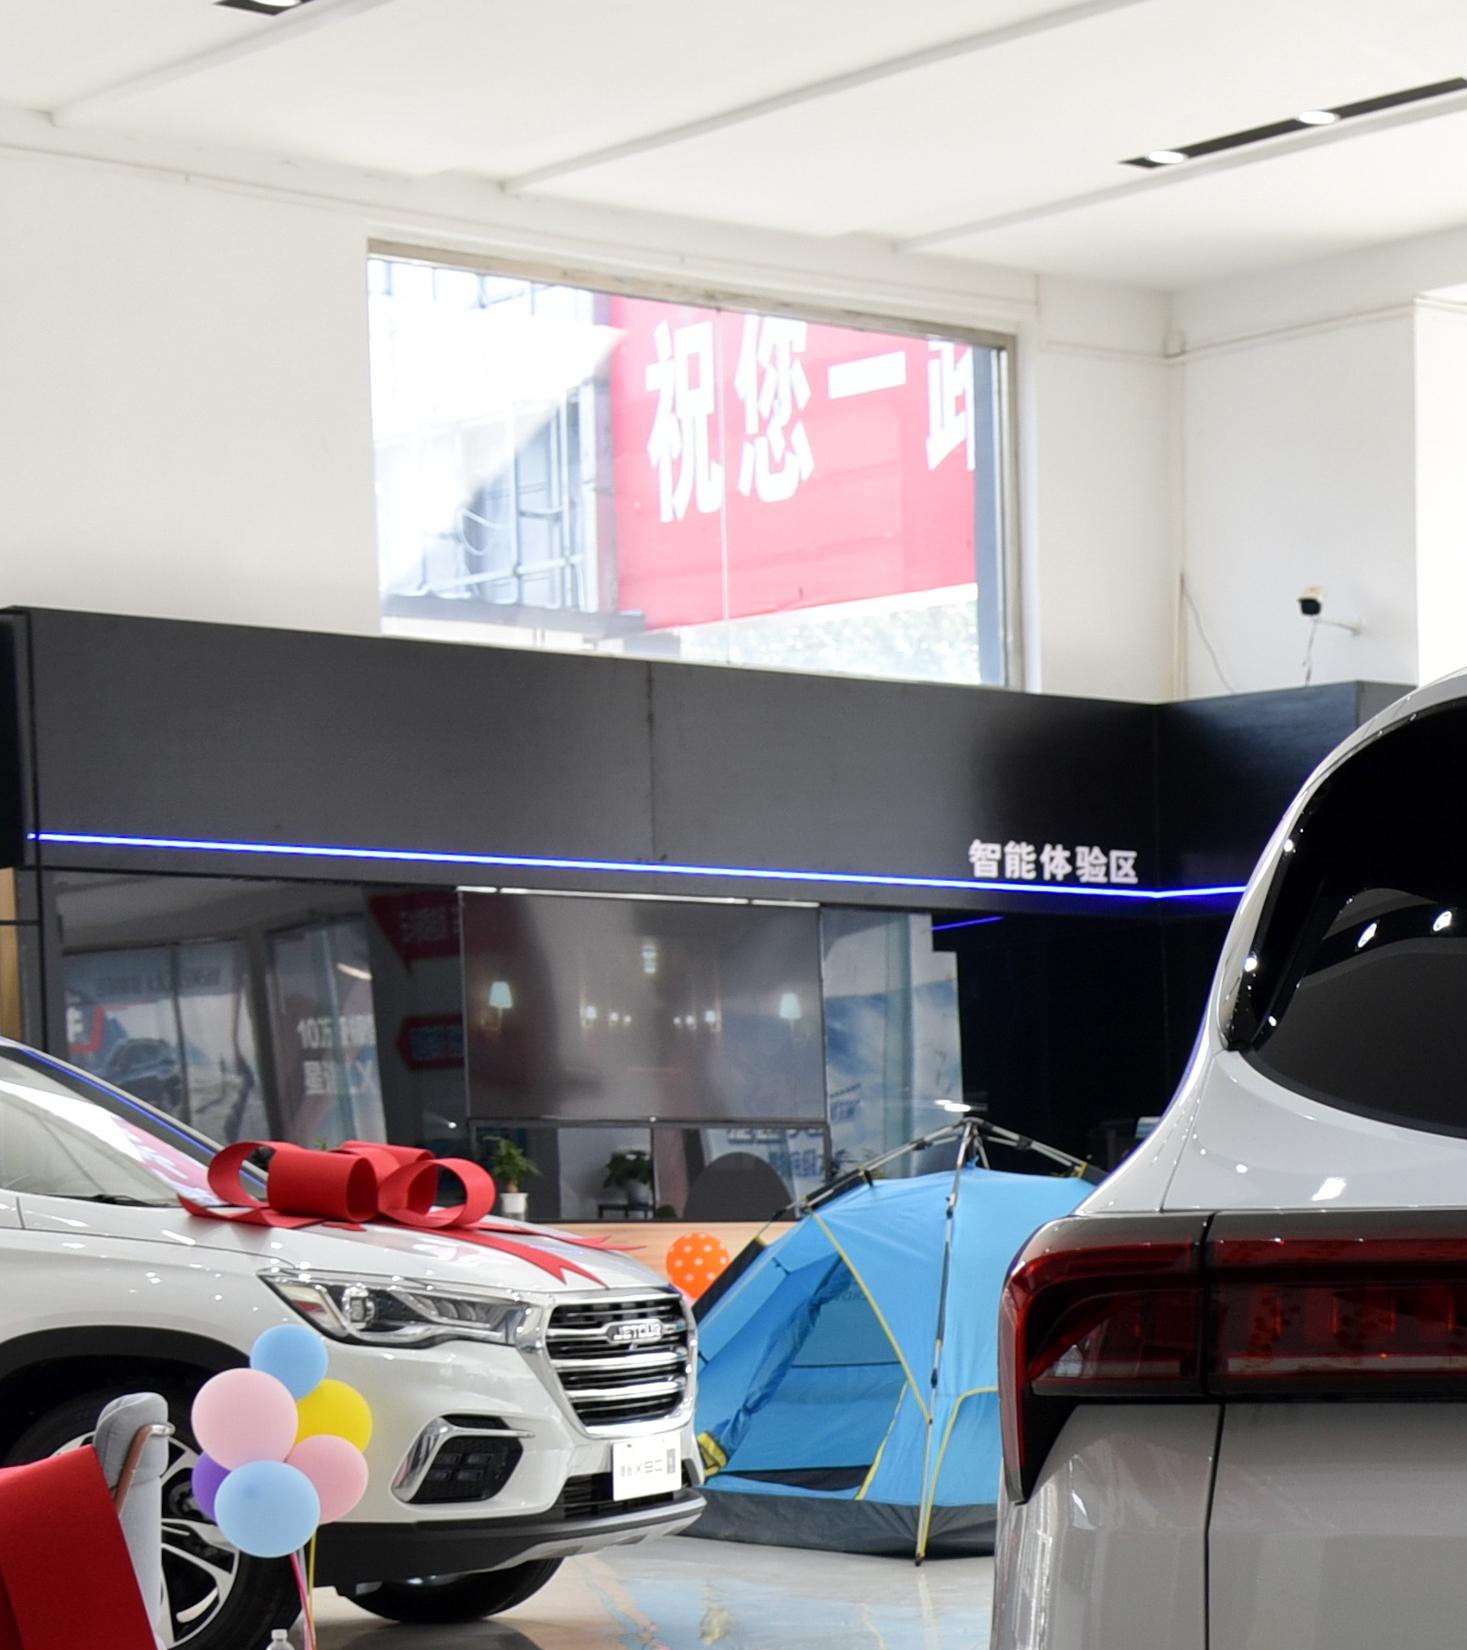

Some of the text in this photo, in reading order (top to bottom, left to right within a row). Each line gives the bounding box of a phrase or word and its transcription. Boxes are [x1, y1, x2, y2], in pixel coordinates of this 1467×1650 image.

[968, 838, 1139, 884] 智能体验区
